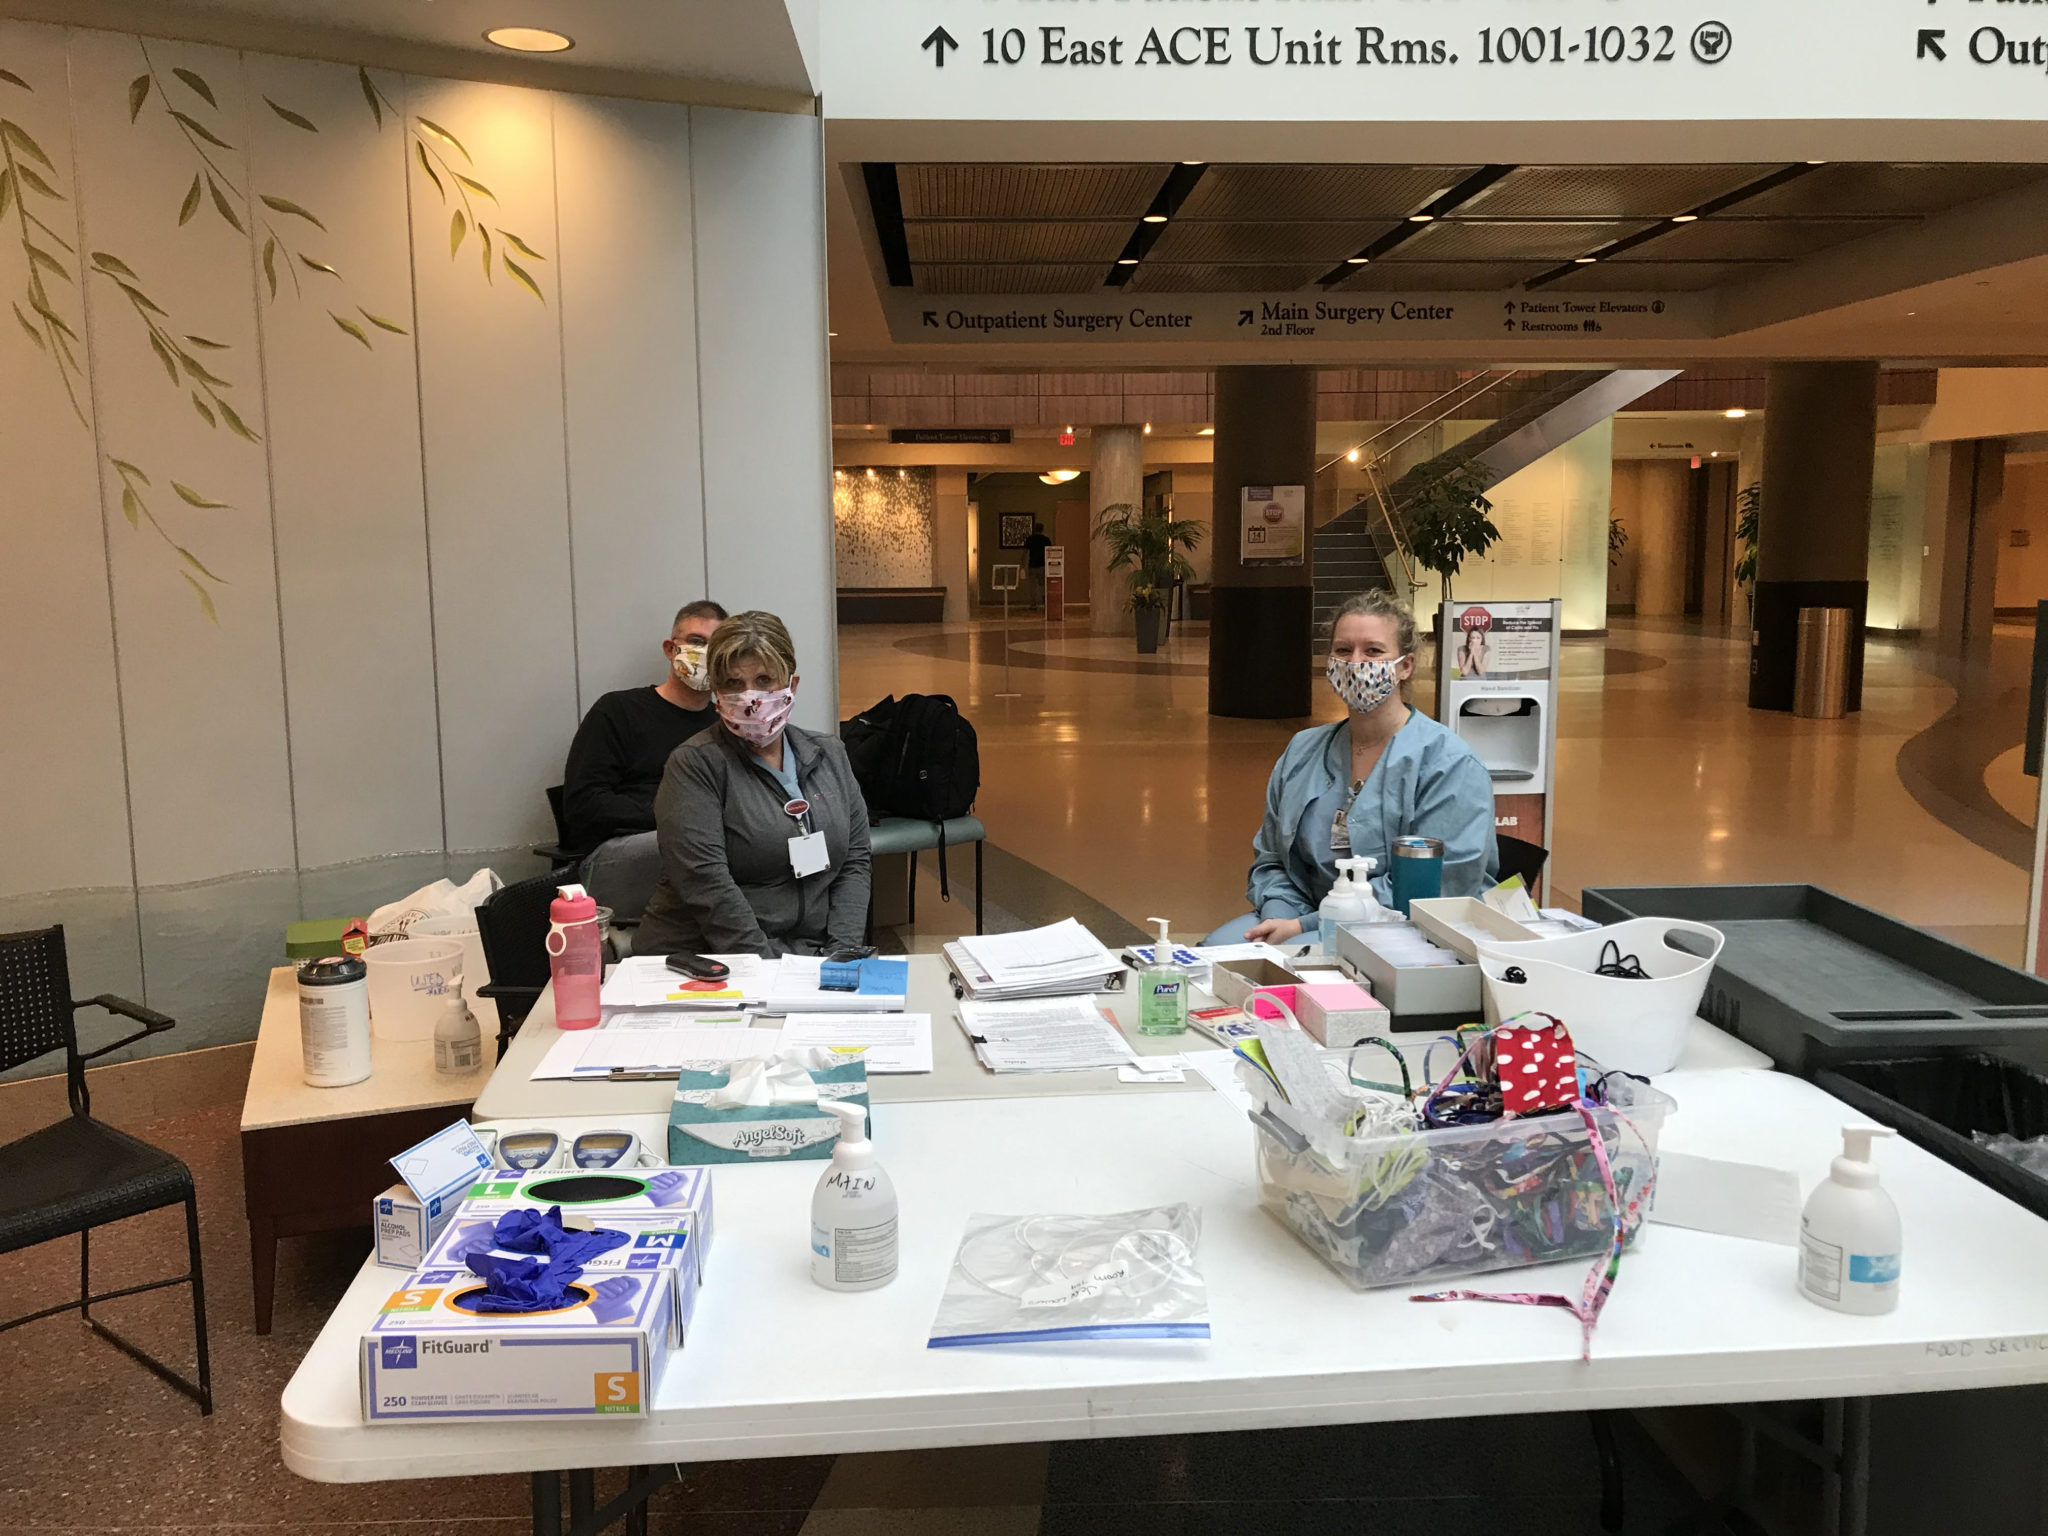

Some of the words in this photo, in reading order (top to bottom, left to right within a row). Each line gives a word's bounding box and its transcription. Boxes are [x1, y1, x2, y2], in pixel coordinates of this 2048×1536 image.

[982, 27, 1026, 65] 10
[1038, 26, 1123, 66] East
[1134, 26, 1232, 66] ACE
[1244, 26, 1342, 66] Unit
[1355, 26, 1459, 65] Rms.
[1477, 25, 1676, 64] 1001-1032
[1968, 26, 2048, 76] Out
[1261, 301, 1310, 321] Main
[1315, 301, 1385, 325] Surgery
[1390, 301, 1454, 320] Center
[1520, 301, 1560, 313] Patient
[1563, 301, 1596, 313] Tower
[1600, 301, 1648, 313] Elevators
[946, 310, 1048, 333] Outpatient
[1052, 309, 1124, 333] Surgery
[1129, 308, 1193, 328] Center
[1521, 320, 1579, 332] Restrooms
[1260, 324, 1282, 336] 2nd
[1286, 323, 1316, 336] Floor
[1463, 615, 1489, 626] STOP
[825, 1171, 876, 1191] MAIN
[483, 1183, 501, 1195] L
[380, 1222, 406, 1231] ALCOHOL
[395, 1230, 412, 1238] PADS
[645, 1234, 676, 1247] M
[399, 1290, 427, 1306] S
[607, 1376, 627, 1401] S
[383, 1396, 407, 1407] 250
